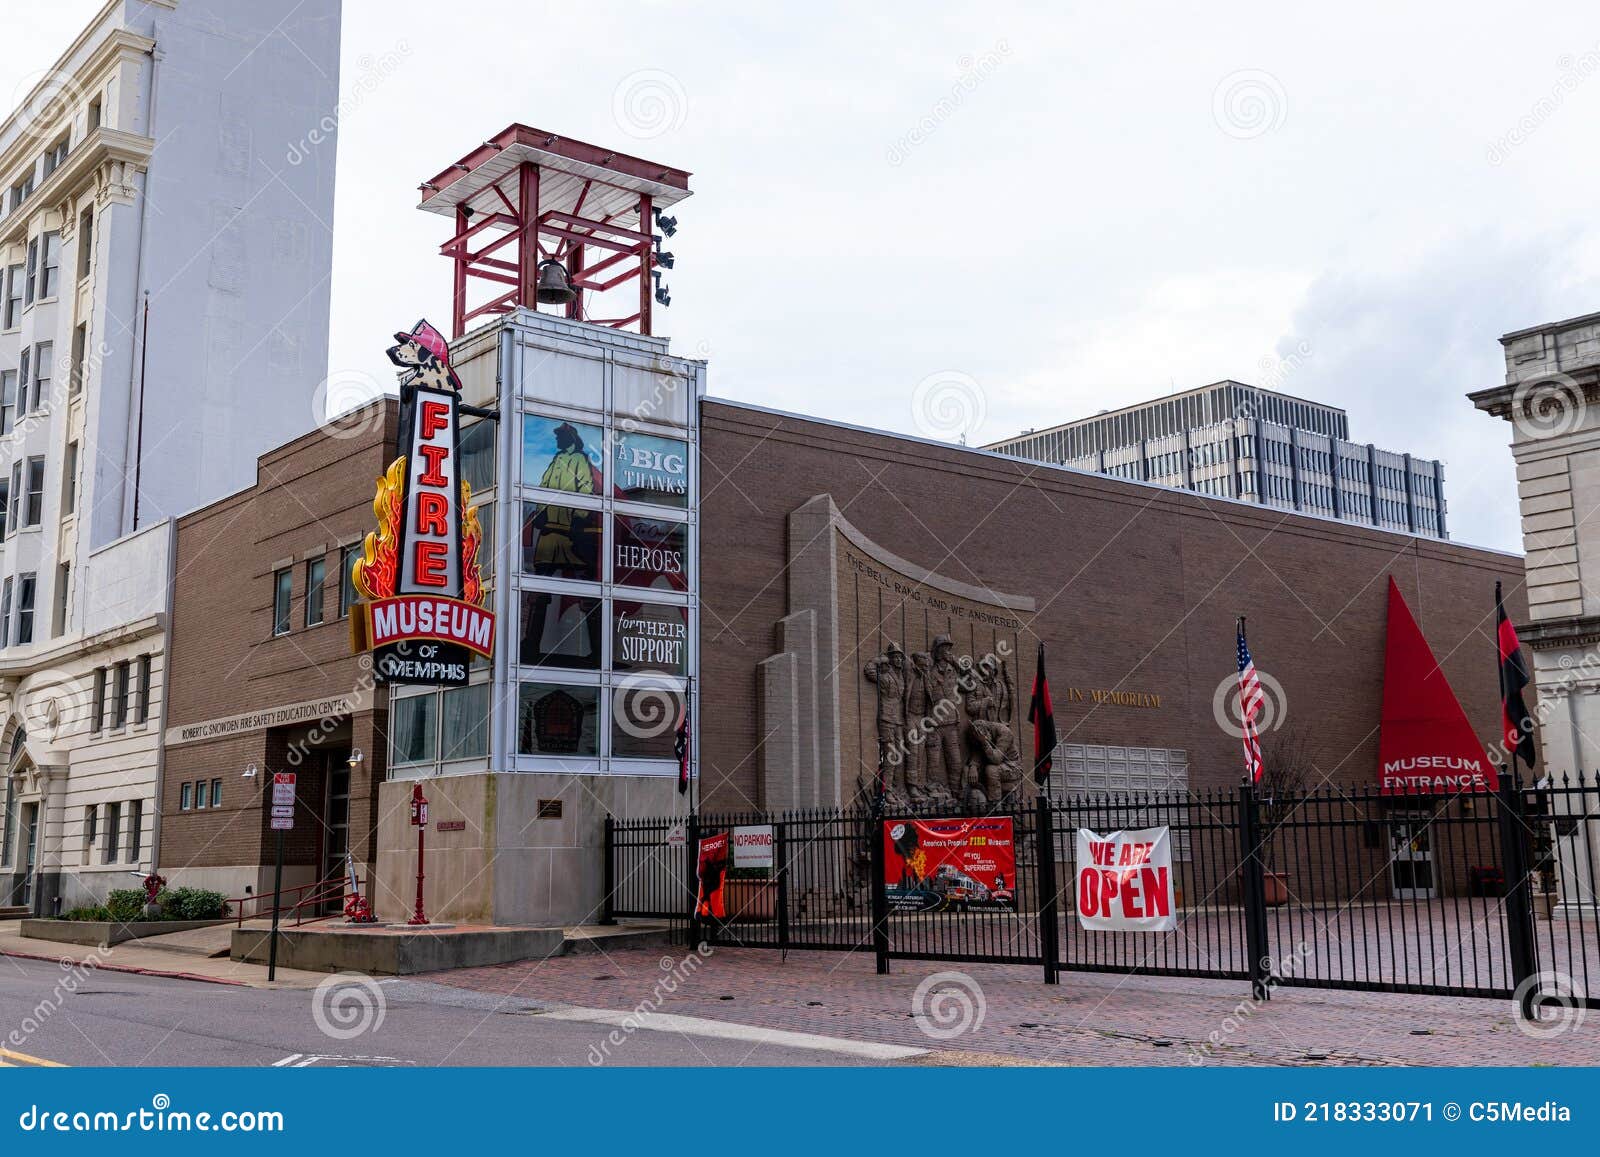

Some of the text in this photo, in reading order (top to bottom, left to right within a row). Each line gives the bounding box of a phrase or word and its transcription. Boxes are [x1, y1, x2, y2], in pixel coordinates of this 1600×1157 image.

[618, 443, 685, 474] A BIG
[415, 400, 450, 587] FIRE
[624, 470, 685, 495] THANKS
[616, 544, 681, 573] HEROES
[846, 551, 865, 573] THE
[867, 566, 892, 588] BELL
[927, 597, 947, 611] AND
[951, 604, 965, 617] WE
[374, 600, 491, 648] MUSEUM
[419, 645, 439, 658] OF
[622, 636, 682, 665] SUPPORT
[388, 660, 465, 680] MEMPHIS
[1067, 687, 1161, 708] IN MEMORIAM
[182, 727, 202, 740] ROBERT
[209, 719, 239, 736] SNOWDEN
[240, 717, 252, 729] FIRE
[253, 712, 276, 728] SAFETY
[276, 705, 317, 723] EDUCATION
[318, 699, 348, 715] CENTER
[1384, 756, 1481, 774] MUSEUM
[1384, 774, 1484, 788] ENTRANCE
[734, 833, 772, 847] NO PARKING
[969, 836, 986, 846] FIRE
[1089, 842, 1153, 867] WE ARE
[1079, 867, 1170, 918] OPEN
